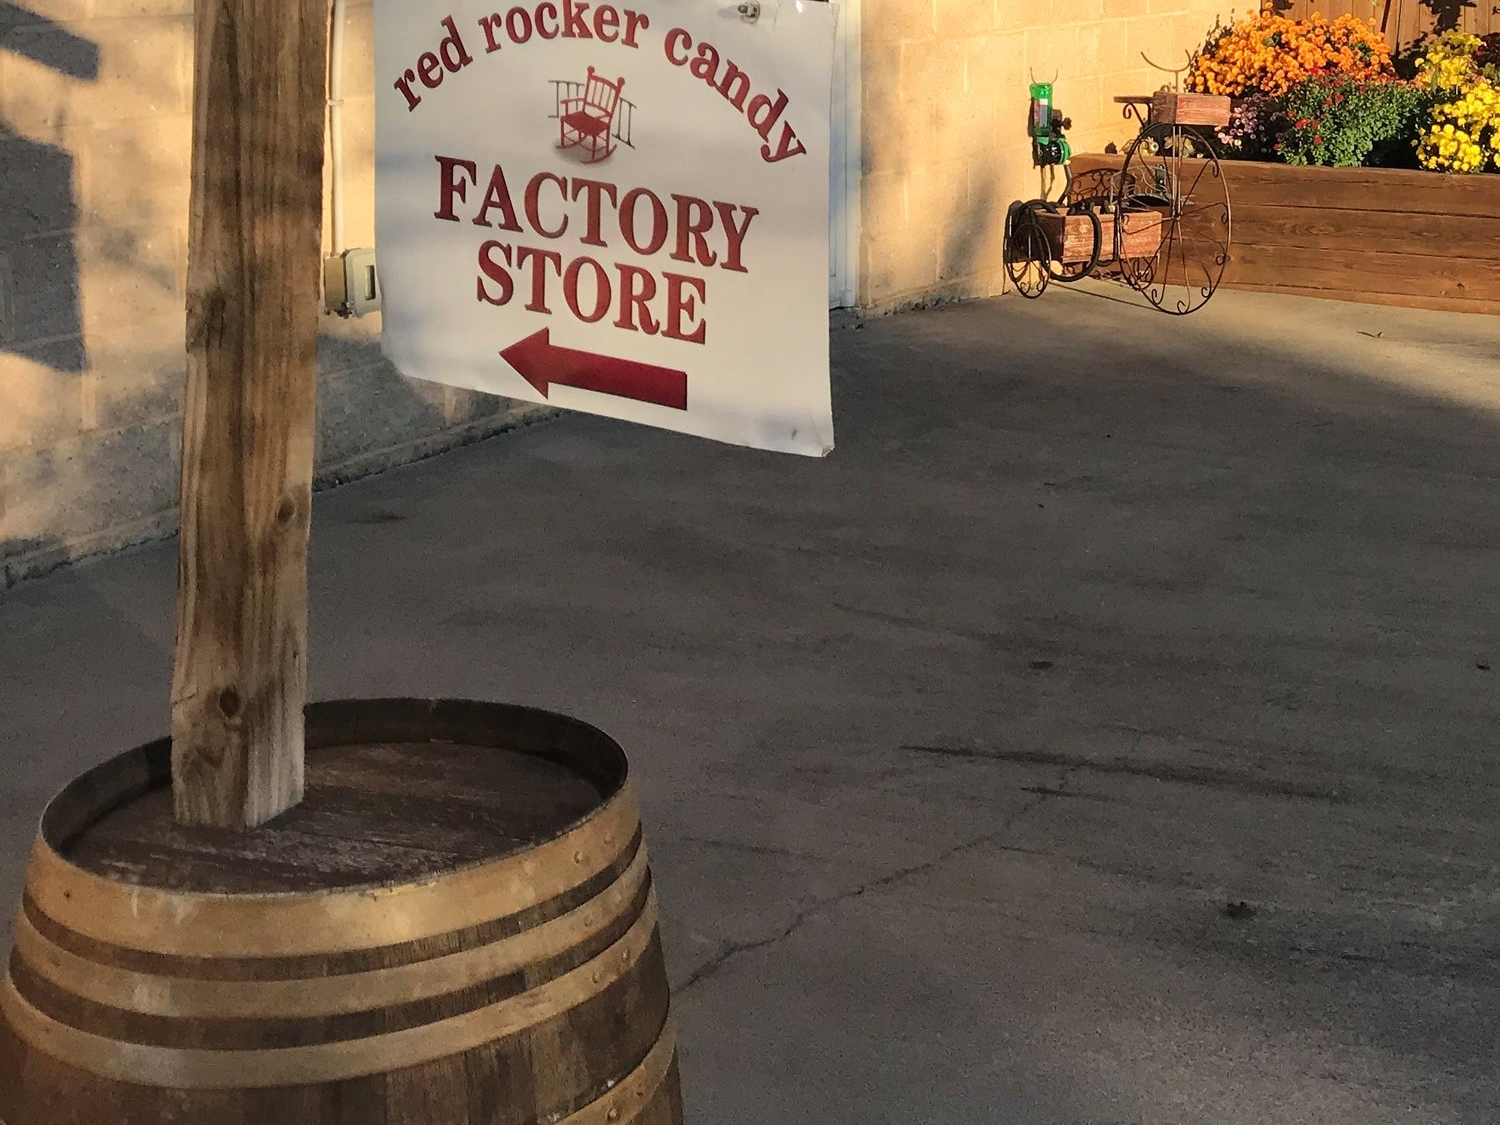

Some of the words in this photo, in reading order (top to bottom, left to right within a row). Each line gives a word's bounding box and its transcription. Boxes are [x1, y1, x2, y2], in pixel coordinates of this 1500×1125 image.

[393, 14, 474, 112] red
[664, 26, 808, 164] candy
[433, 154, 760, 274] FACTORY
[476, 238, 707, 346] STORE
